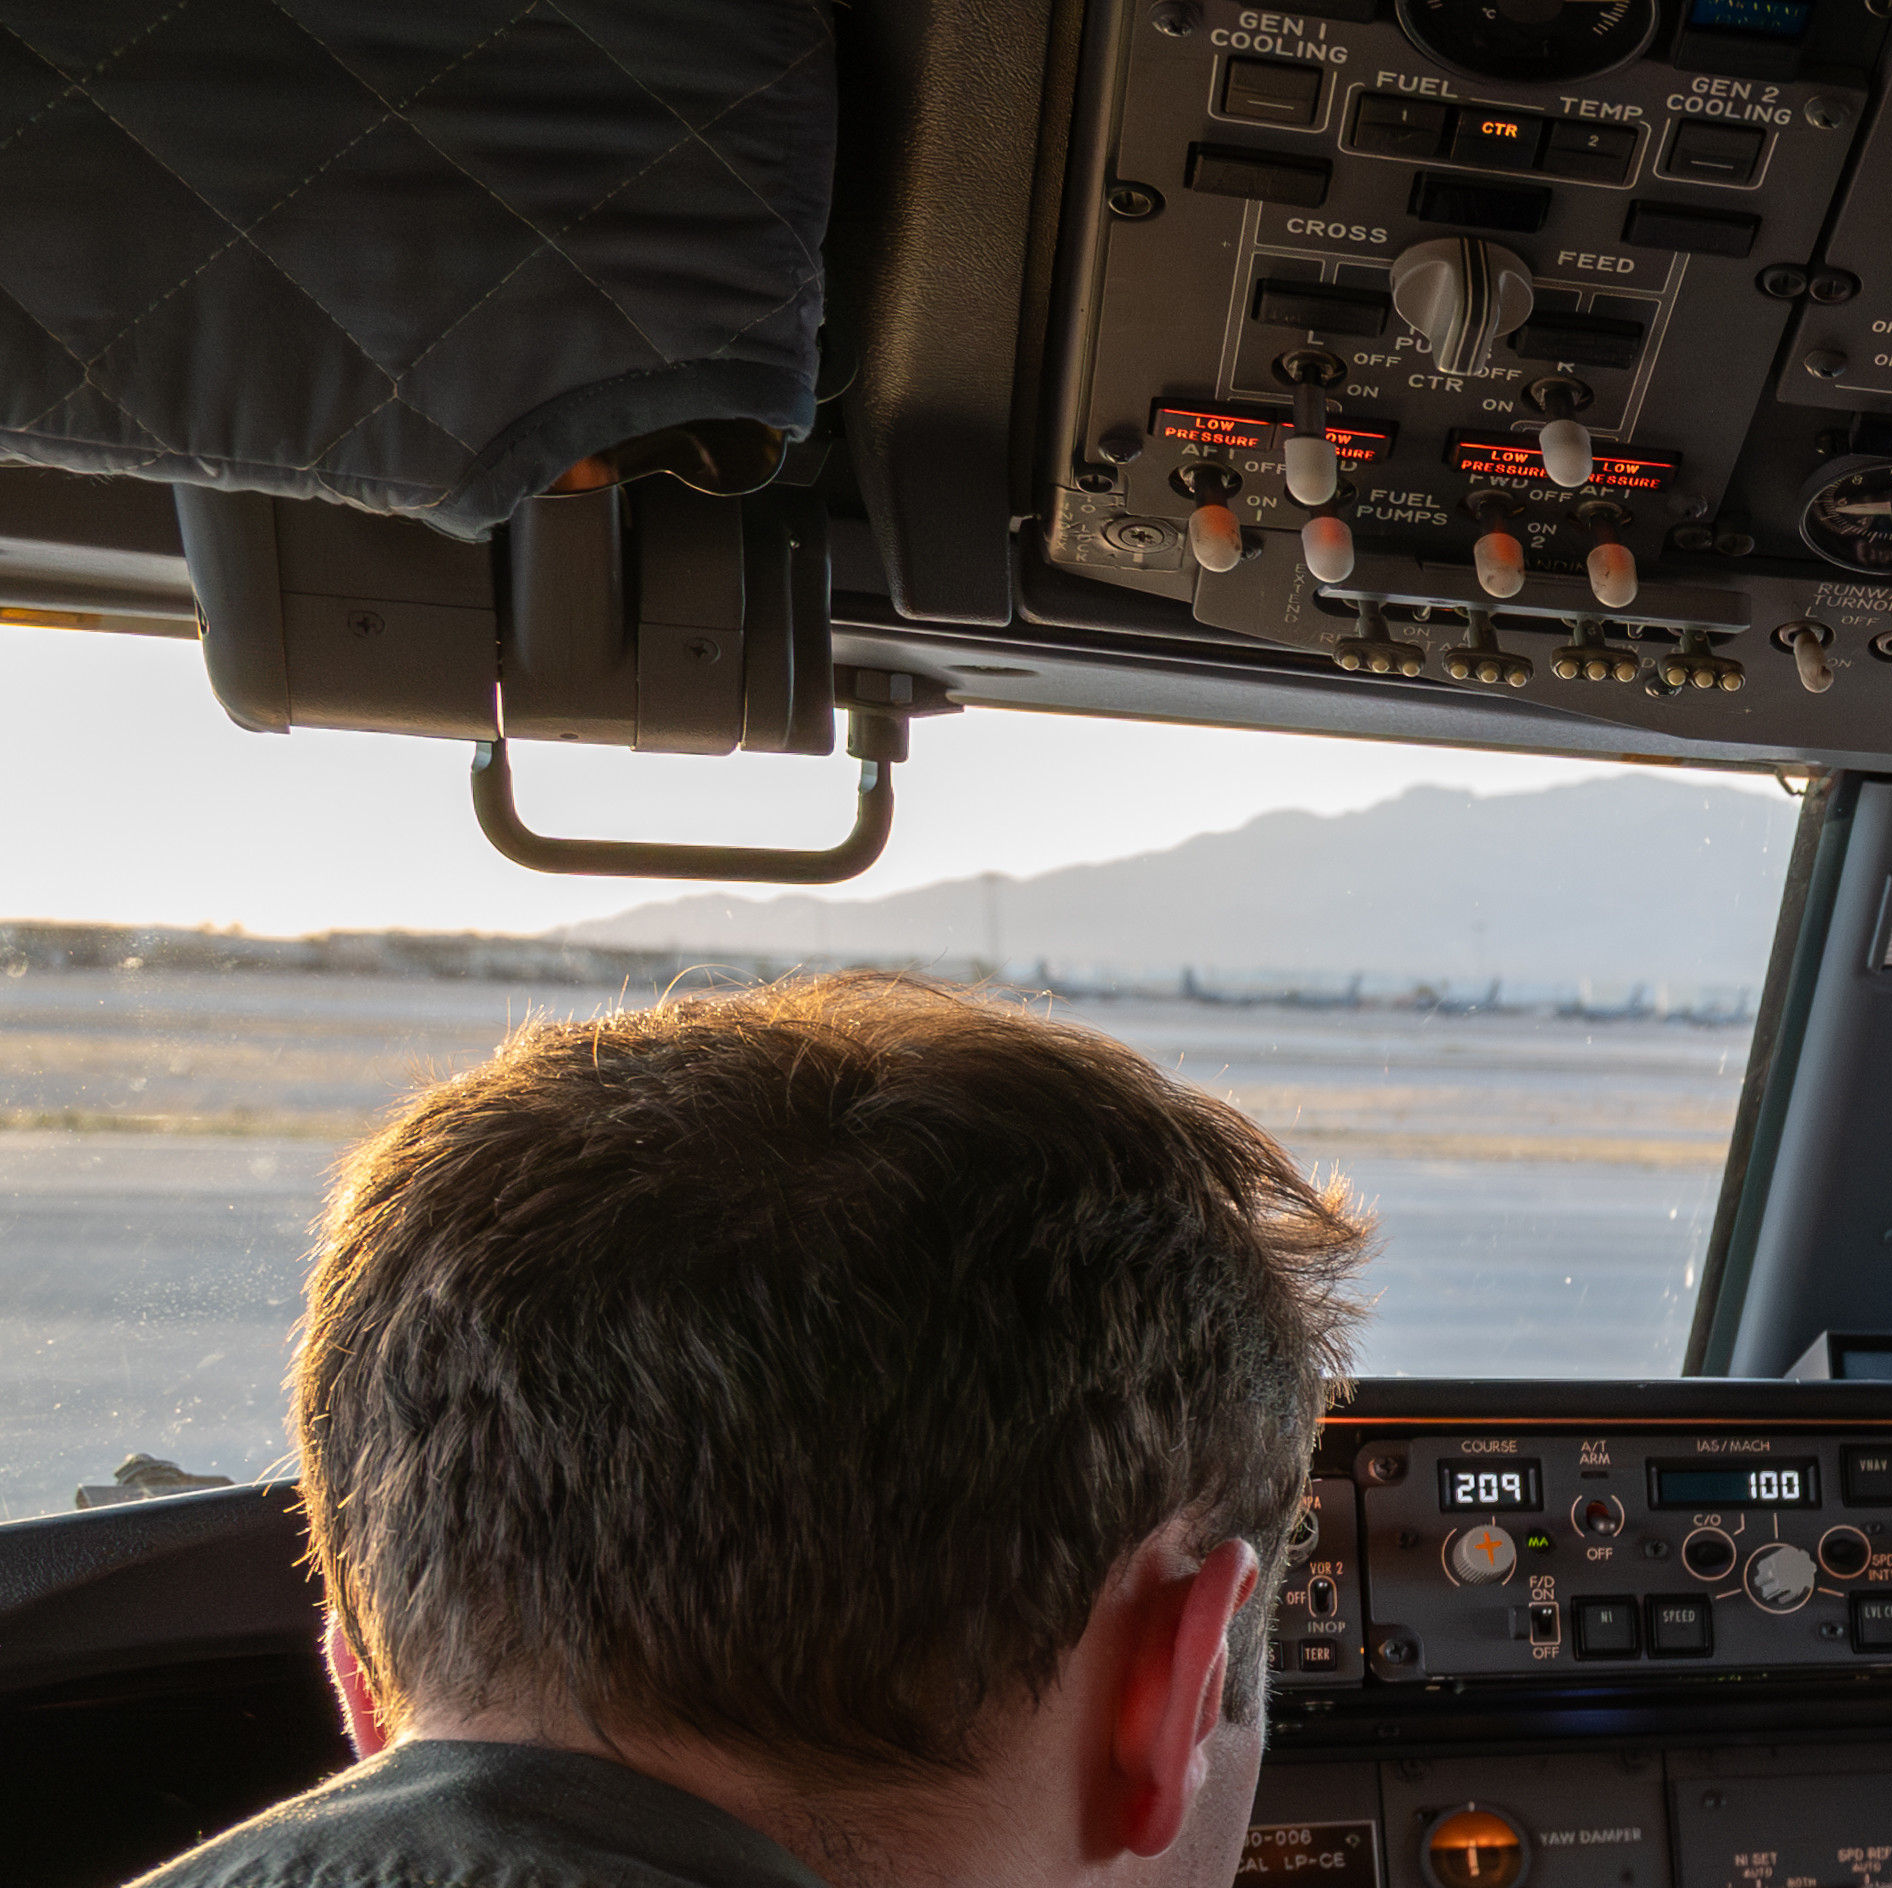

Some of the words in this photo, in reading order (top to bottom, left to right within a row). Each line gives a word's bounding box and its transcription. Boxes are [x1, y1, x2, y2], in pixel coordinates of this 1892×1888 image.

[1239, 11, 1304, 36] GEN
[1210, 28, 1348, 64] COOLING
[1376, 70, 1458, 98] FUEL
[1560, 96, 1643, 122] TEMP
[1692, 77, 1752, 100] GEN
[1761, 86, 1780, 103] 2
[1666, 94, 1792, 125] COOLING
[1481, 121, 1519, 139] CTR
[1286, 218, 1388, 244] CROSS
[1557, 251, 1635, 275] FEED
[1354, 353, 1402, 369] OFF
[1408, 374, 1464, 393] CTR
[1346, 384, 1380, 399] ON
[1482, 399, 1514, 413] ON
[1195, 418, 1235, 432] LOW
[1165, 427, 1260, 448] PRESSURE
[1491, 450, 1529, 463] LOW
[1602, 461, 1640, 474] LOW
[1246, 495, 1277, 508] ON
[1369, 488, 1441, 509] FUEL
[1529, 489, 1574, 503] OFF
[1356, 505, 1448, 526] PUMPS
[1527, 522, 1557, 535] ON
[1461, 1441, 1518, 1453] COURSE
[1581, 1441, 1607, 1453] A/T
[1579, 1453, 1611, 1466] ARM
[1455, 1472, 1521, 1504] 209
[1749, 1470, 1801, 1500] 100
[1528, 1536, 1549, 1548] MA
[1587, 1548, 1613, 1561] OFF
[1287, 1592, 1307, 1605] OFF
[1532, 1588, 1556, 1601] ON
[1307, 1622, 1346, 1634] INOP
[1304, 1648, 1331, 1661] TERR
[1533, 1647, 1560, 1660] OFF
